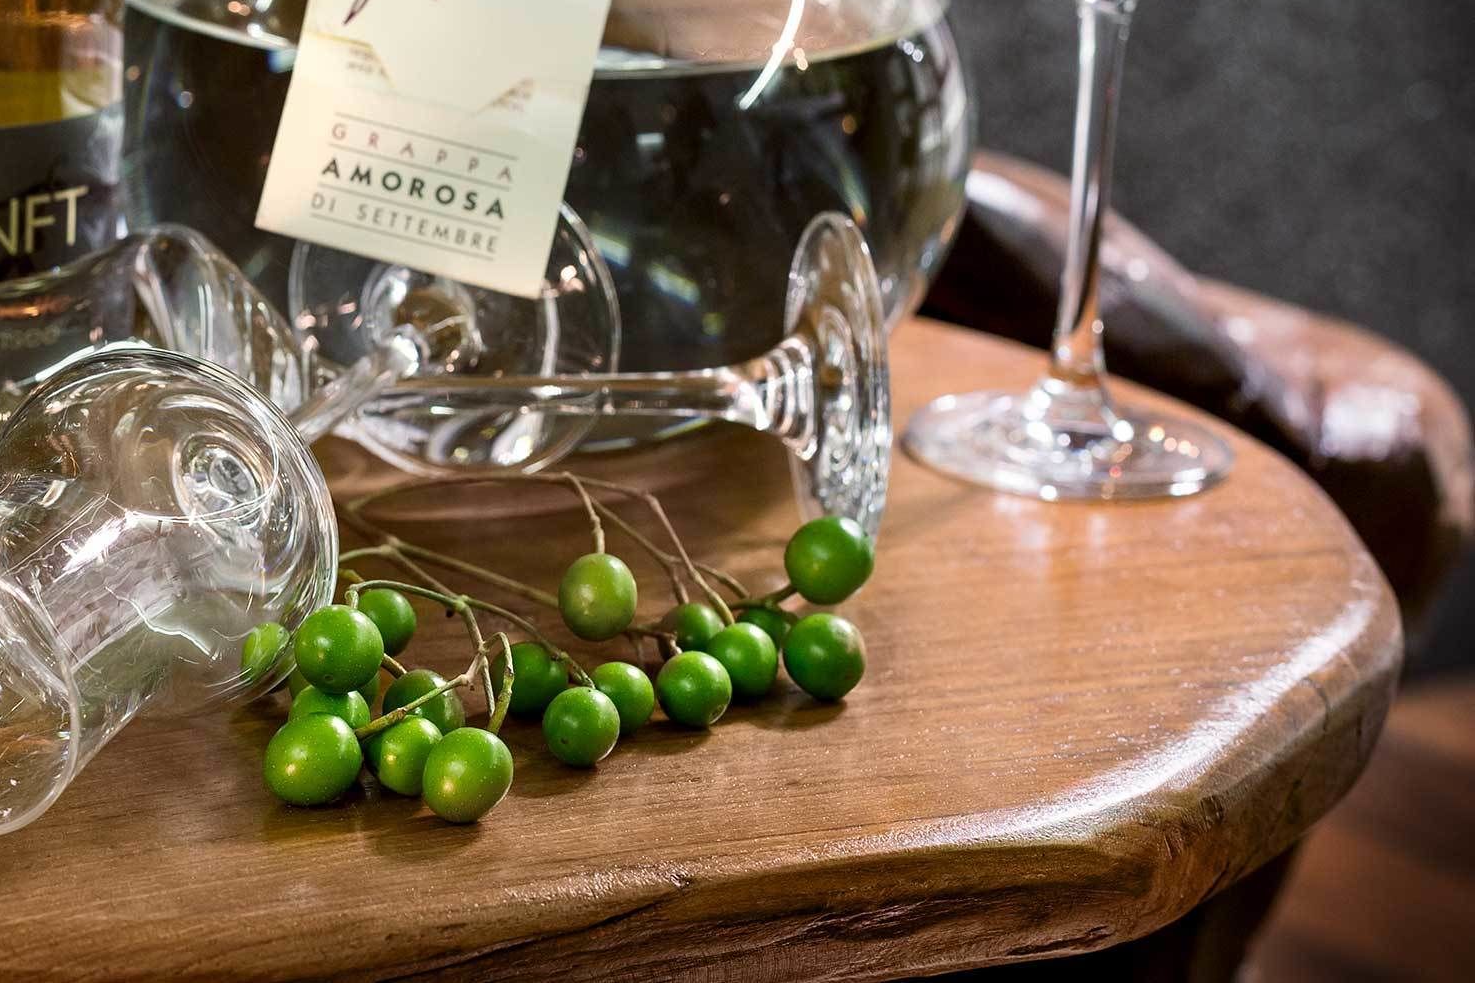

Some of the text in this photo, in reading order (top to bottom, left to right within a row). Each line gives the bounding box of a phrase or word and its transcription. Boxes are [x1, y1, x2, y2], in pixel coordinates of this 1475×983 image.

[331, 122, 513, 183] GRAPPA
[321, 157, 505, 220] AMOROSA
[310, 192, 500, 254] DI SETTEMBRE
